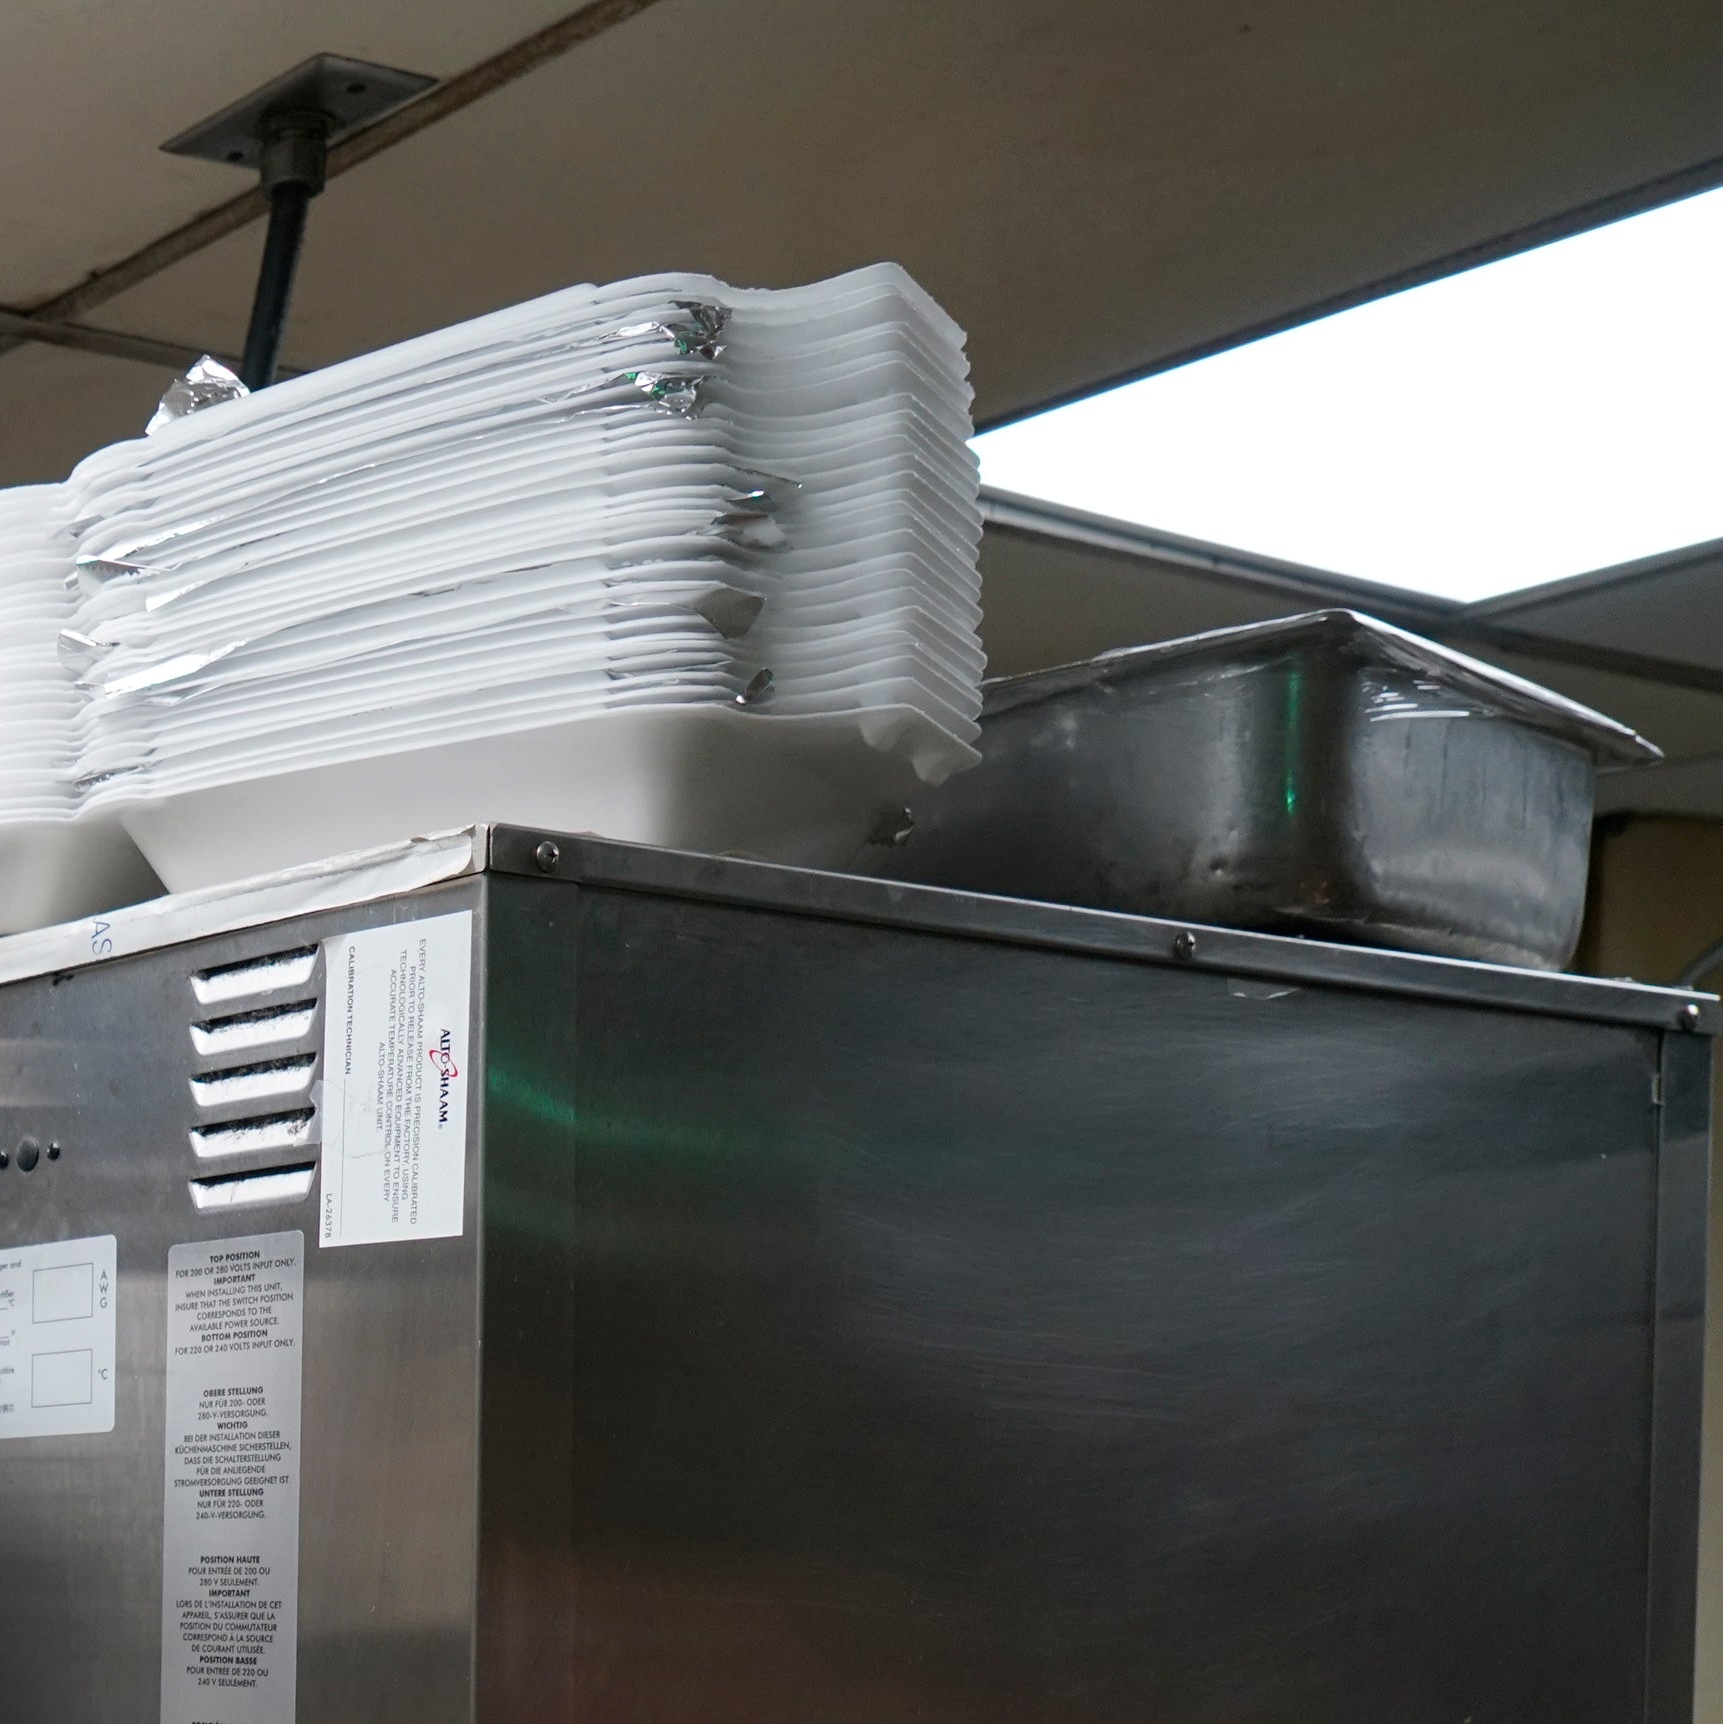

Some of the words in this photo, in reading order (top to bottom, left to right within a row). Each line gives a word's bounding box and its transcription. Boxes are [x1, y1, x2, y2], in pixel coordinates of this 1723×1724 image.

[347, 946, 355, 1013] CALIBRATION
[417, 975, 425, 1039] ALTO-SHAAM
[345, 1014, 353, 1075] TECHNICIAN
[415, 1041, 423, 1090] PRODUCT
[414, 1093, 422, 1103] IS
[412, 1105, 421, 1161] PRECISION
[324, 1193, 333, 1238] LA-26378
[410, 1163, 419, 1225] CALIBRATED
[176, 1269, 189, 1278] FOR
[190, 1268, 203, 1277] 200
[204, 1266, 214, 1275] OR
[216, 1265, 229, 1274] 280
[229, 1262, 251, 1272] VOLTS
[252, 1260, 273, 1270] INPUT
[274, 1257, 295, 1268] ONLY.
[210, 1254, 224, 1263] TOP
[225, 1251, 260, 1261] POSITION
[214, 1273, 256, 1284] IMPORTANT
[201, 1332, 231, 1342] BOTTOM
[233, 1329, 268, 1339] POSITION
